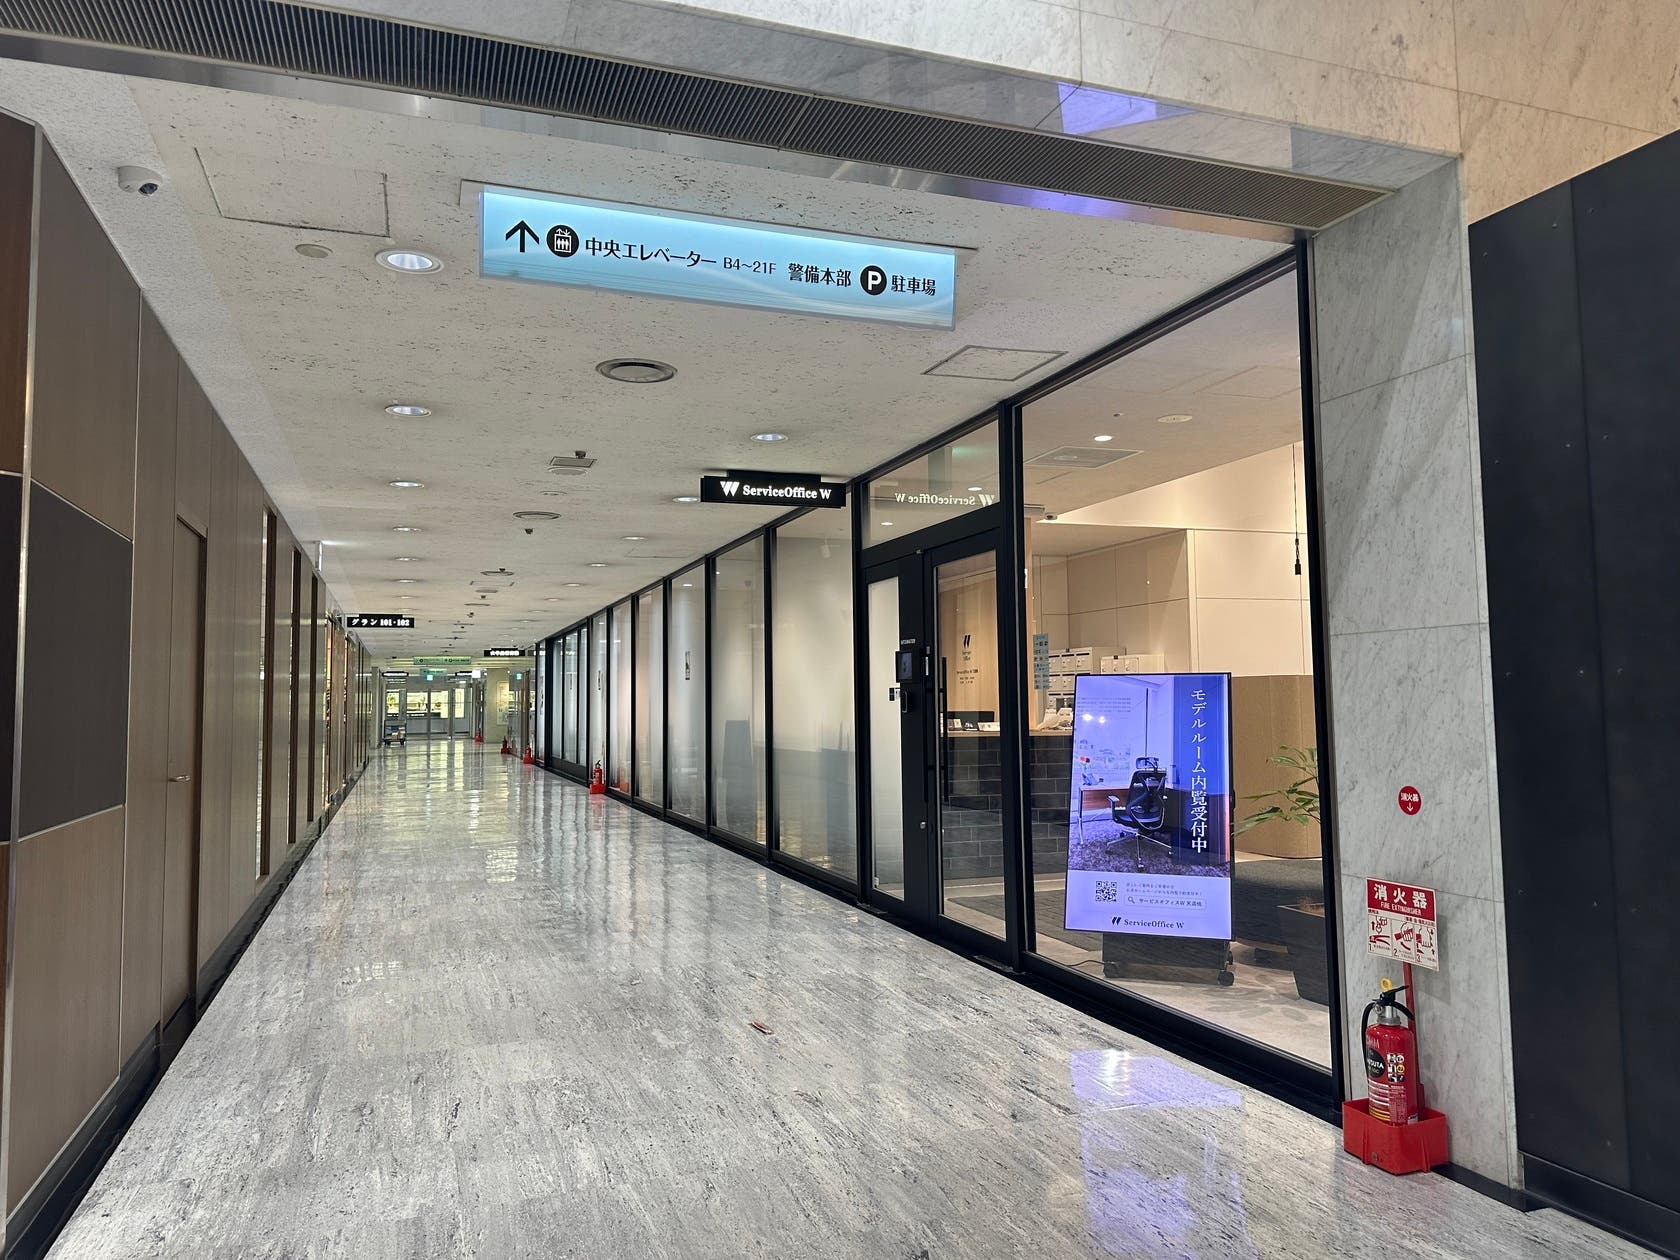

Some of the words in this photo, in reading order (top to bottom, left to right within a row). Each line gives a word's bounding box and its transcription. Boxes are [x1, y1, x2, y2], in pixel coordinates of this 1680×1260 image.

[585, 237, 717, 267] 中央エレベーター
[788, 262, 851, 288] 警備本部
[891, 274, 936, 296] 駐車場
[743, 484, 818, 499] ServiceOffice
[819, 488, 832, 500] W
[352, 618, 378, 626] グラン
[1190, 689, 1208, 854] モデルルーム内覧受付中
[1373, 883, 1428, 909] 消火器
[1380, 901, 1391, 910] FIRE
[1124, 918, 1175, 929] ServiceOffice
[1176, 921, 1185, 929] W
